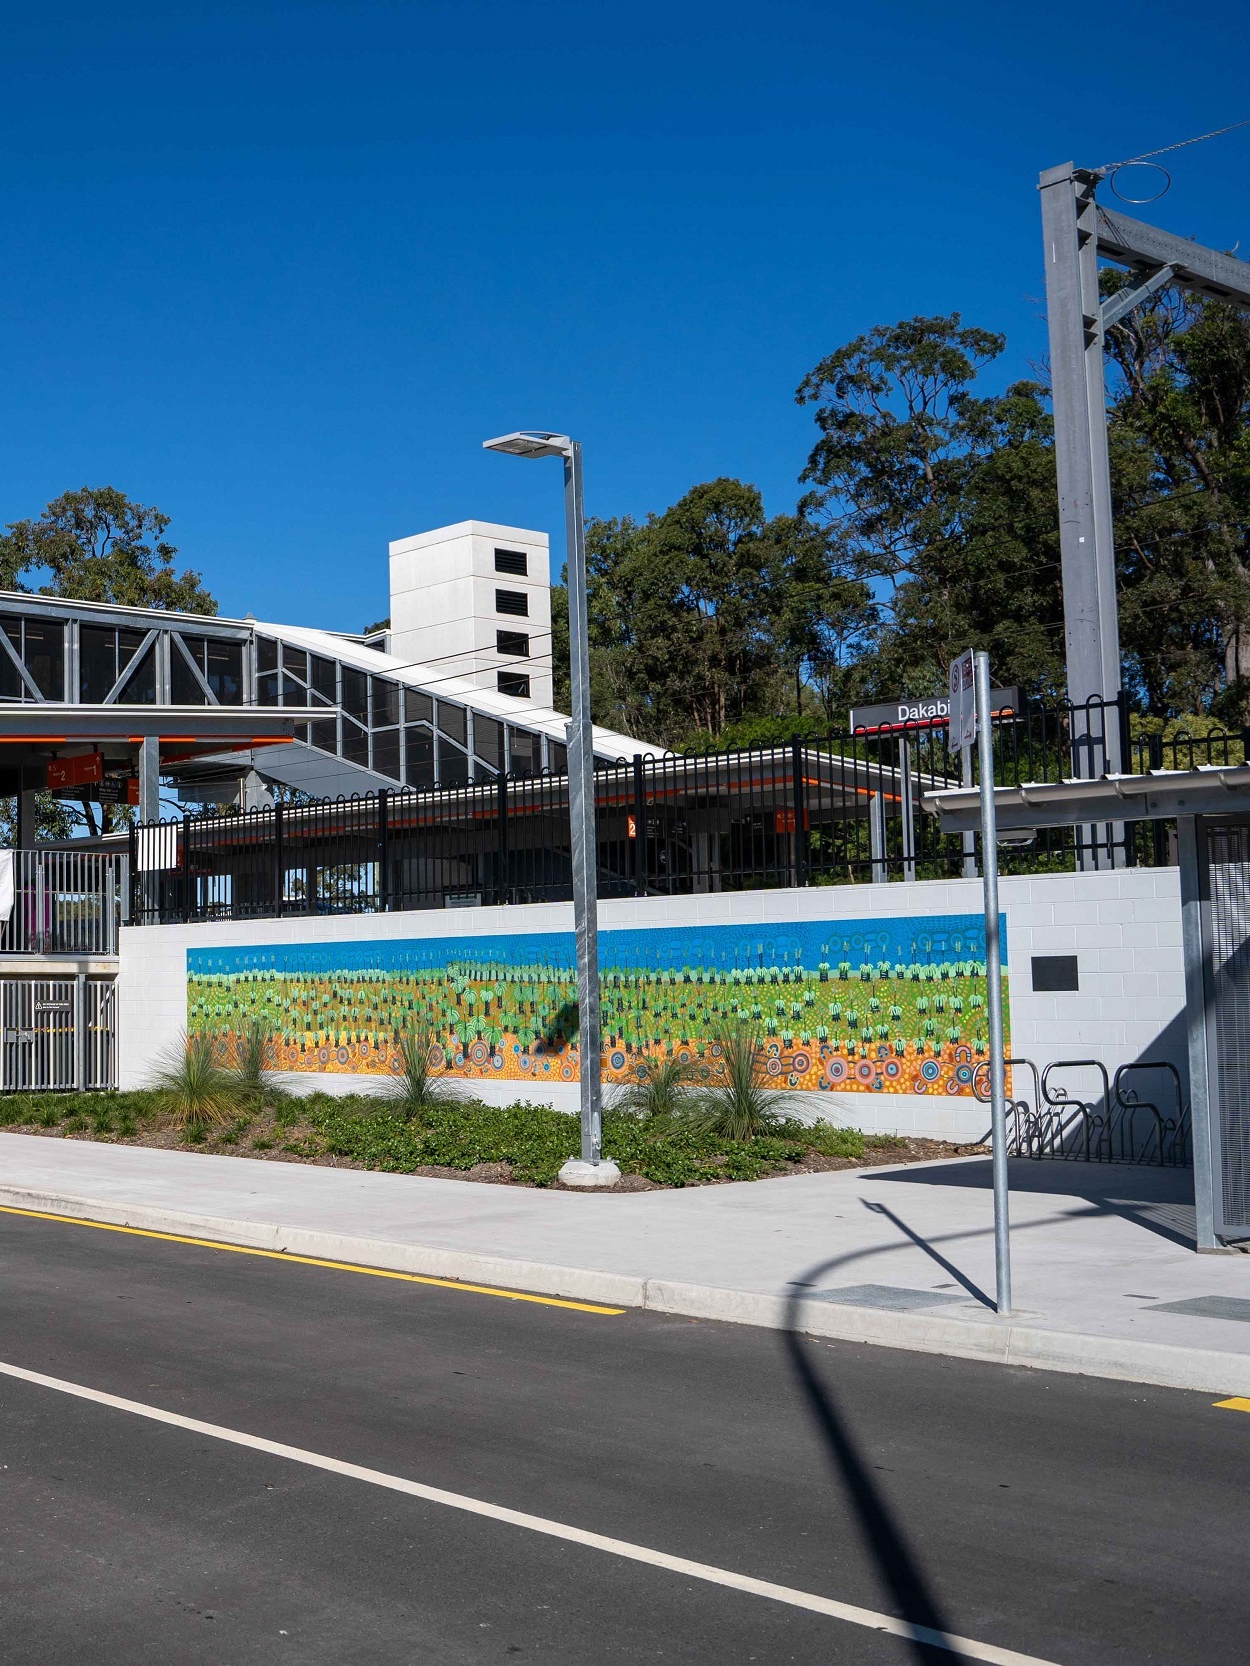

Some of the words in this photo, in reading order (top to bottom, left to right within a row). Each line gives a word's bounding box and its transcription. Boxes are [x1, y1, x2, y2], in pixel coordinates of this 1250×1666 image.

[898, 699, 951, 721] Dakabi
[60, 770, 66, 781] 2
[629, 823, 636, 835] 2
